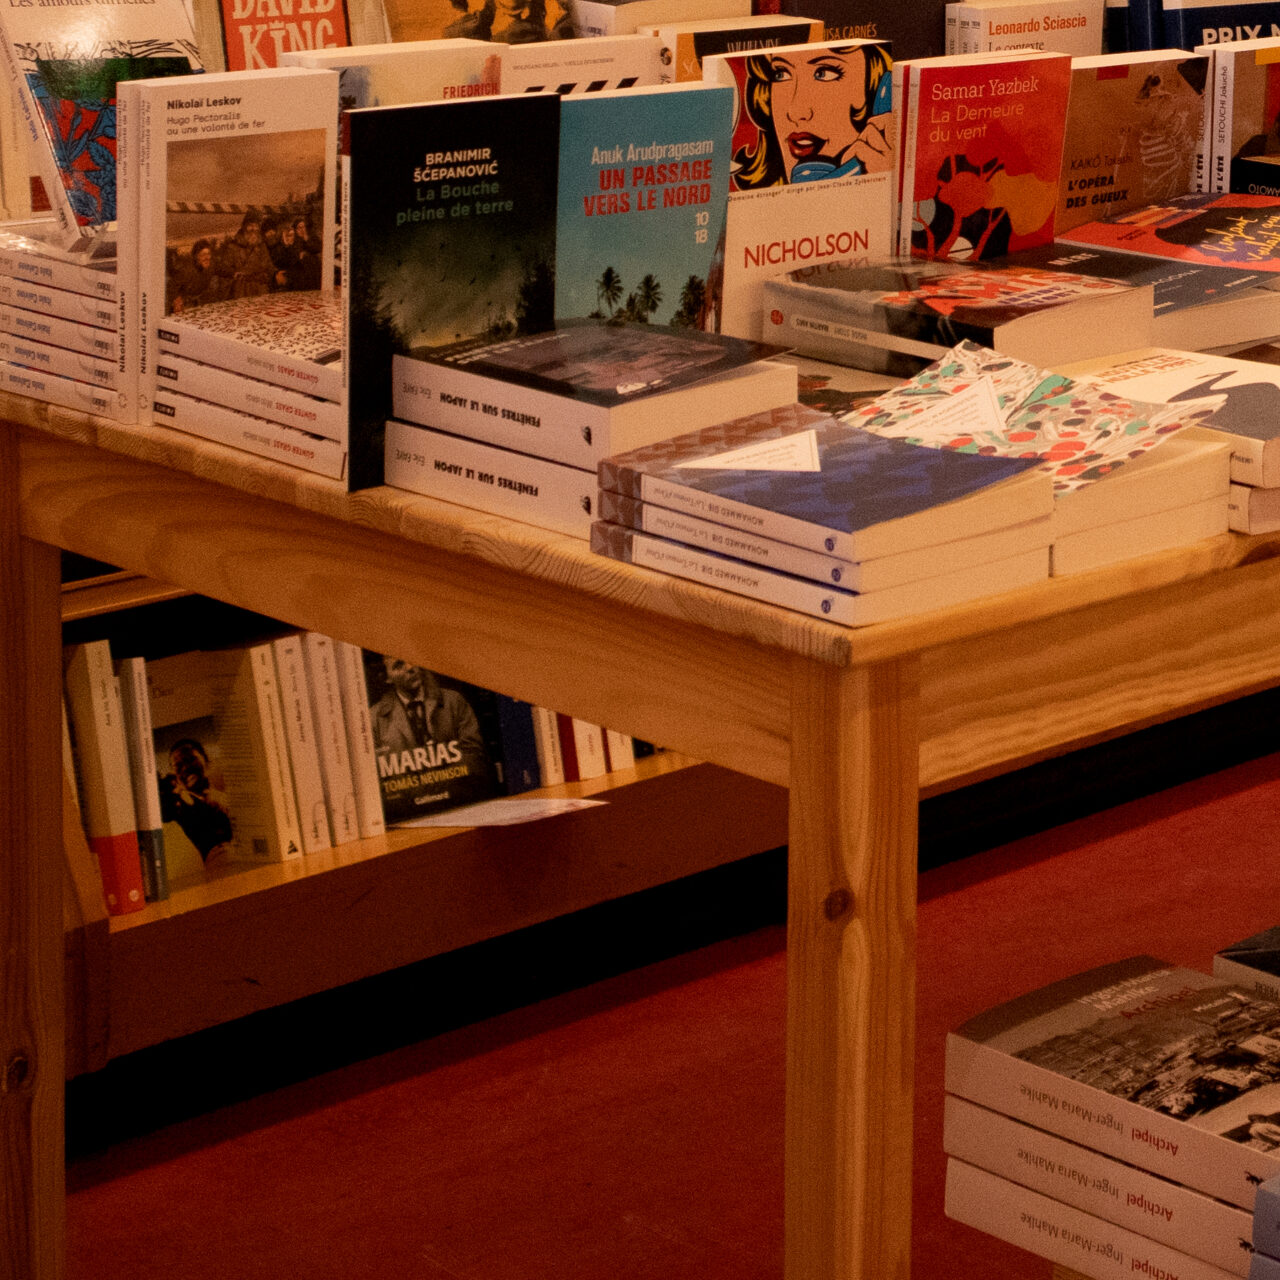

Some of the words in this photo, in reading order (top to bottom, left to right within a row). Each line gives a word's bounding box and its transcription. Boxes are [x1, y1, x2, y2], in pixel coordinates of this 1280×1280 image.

[989, 18, 1039, 37] Leonardo
[1042, 13, 1087, 32] Sciascia
[238, 20, 338, 70] KING
[205, 93, 242, 108] Leskov
[932, 81, 985, 102] Samar
[988, 76, 1039, 96] Yazbek
[1217, 99, 1226, 144] SETOUCHI
[425, 147, 491, 166] BRANIMIR
[591, 144, 623, 165] Anuk
[626, 139, 714, 164] Arudpragasam
[599, 169, 627, 189] UN
[631, 159, 712, 188] PASSAGE
[583, 195, 632, 217] VERS
[636, 191, 657, 212] LE
[662, 182, 711, 210] NORD
[743, 228, 869, 269] NICHOLSON
[439, 392, 461, 407] JAPON
[465, 398, 478, 413] LE
[482, 403, 499, 418] SUR
[500, 409, 541, 428] FENÊTRES
[379, 739, 463, 779] MARÍAS
[384, 775, 419, 794] TOMÁS
[420, 765, 469, 785] NEVINSON
[1020, 1084, 1058, 1109] Mahlke
[1061, 1100, 1124, 1135] Inger-Maria
[1131, 1128, 1179, 1156] Archipel
